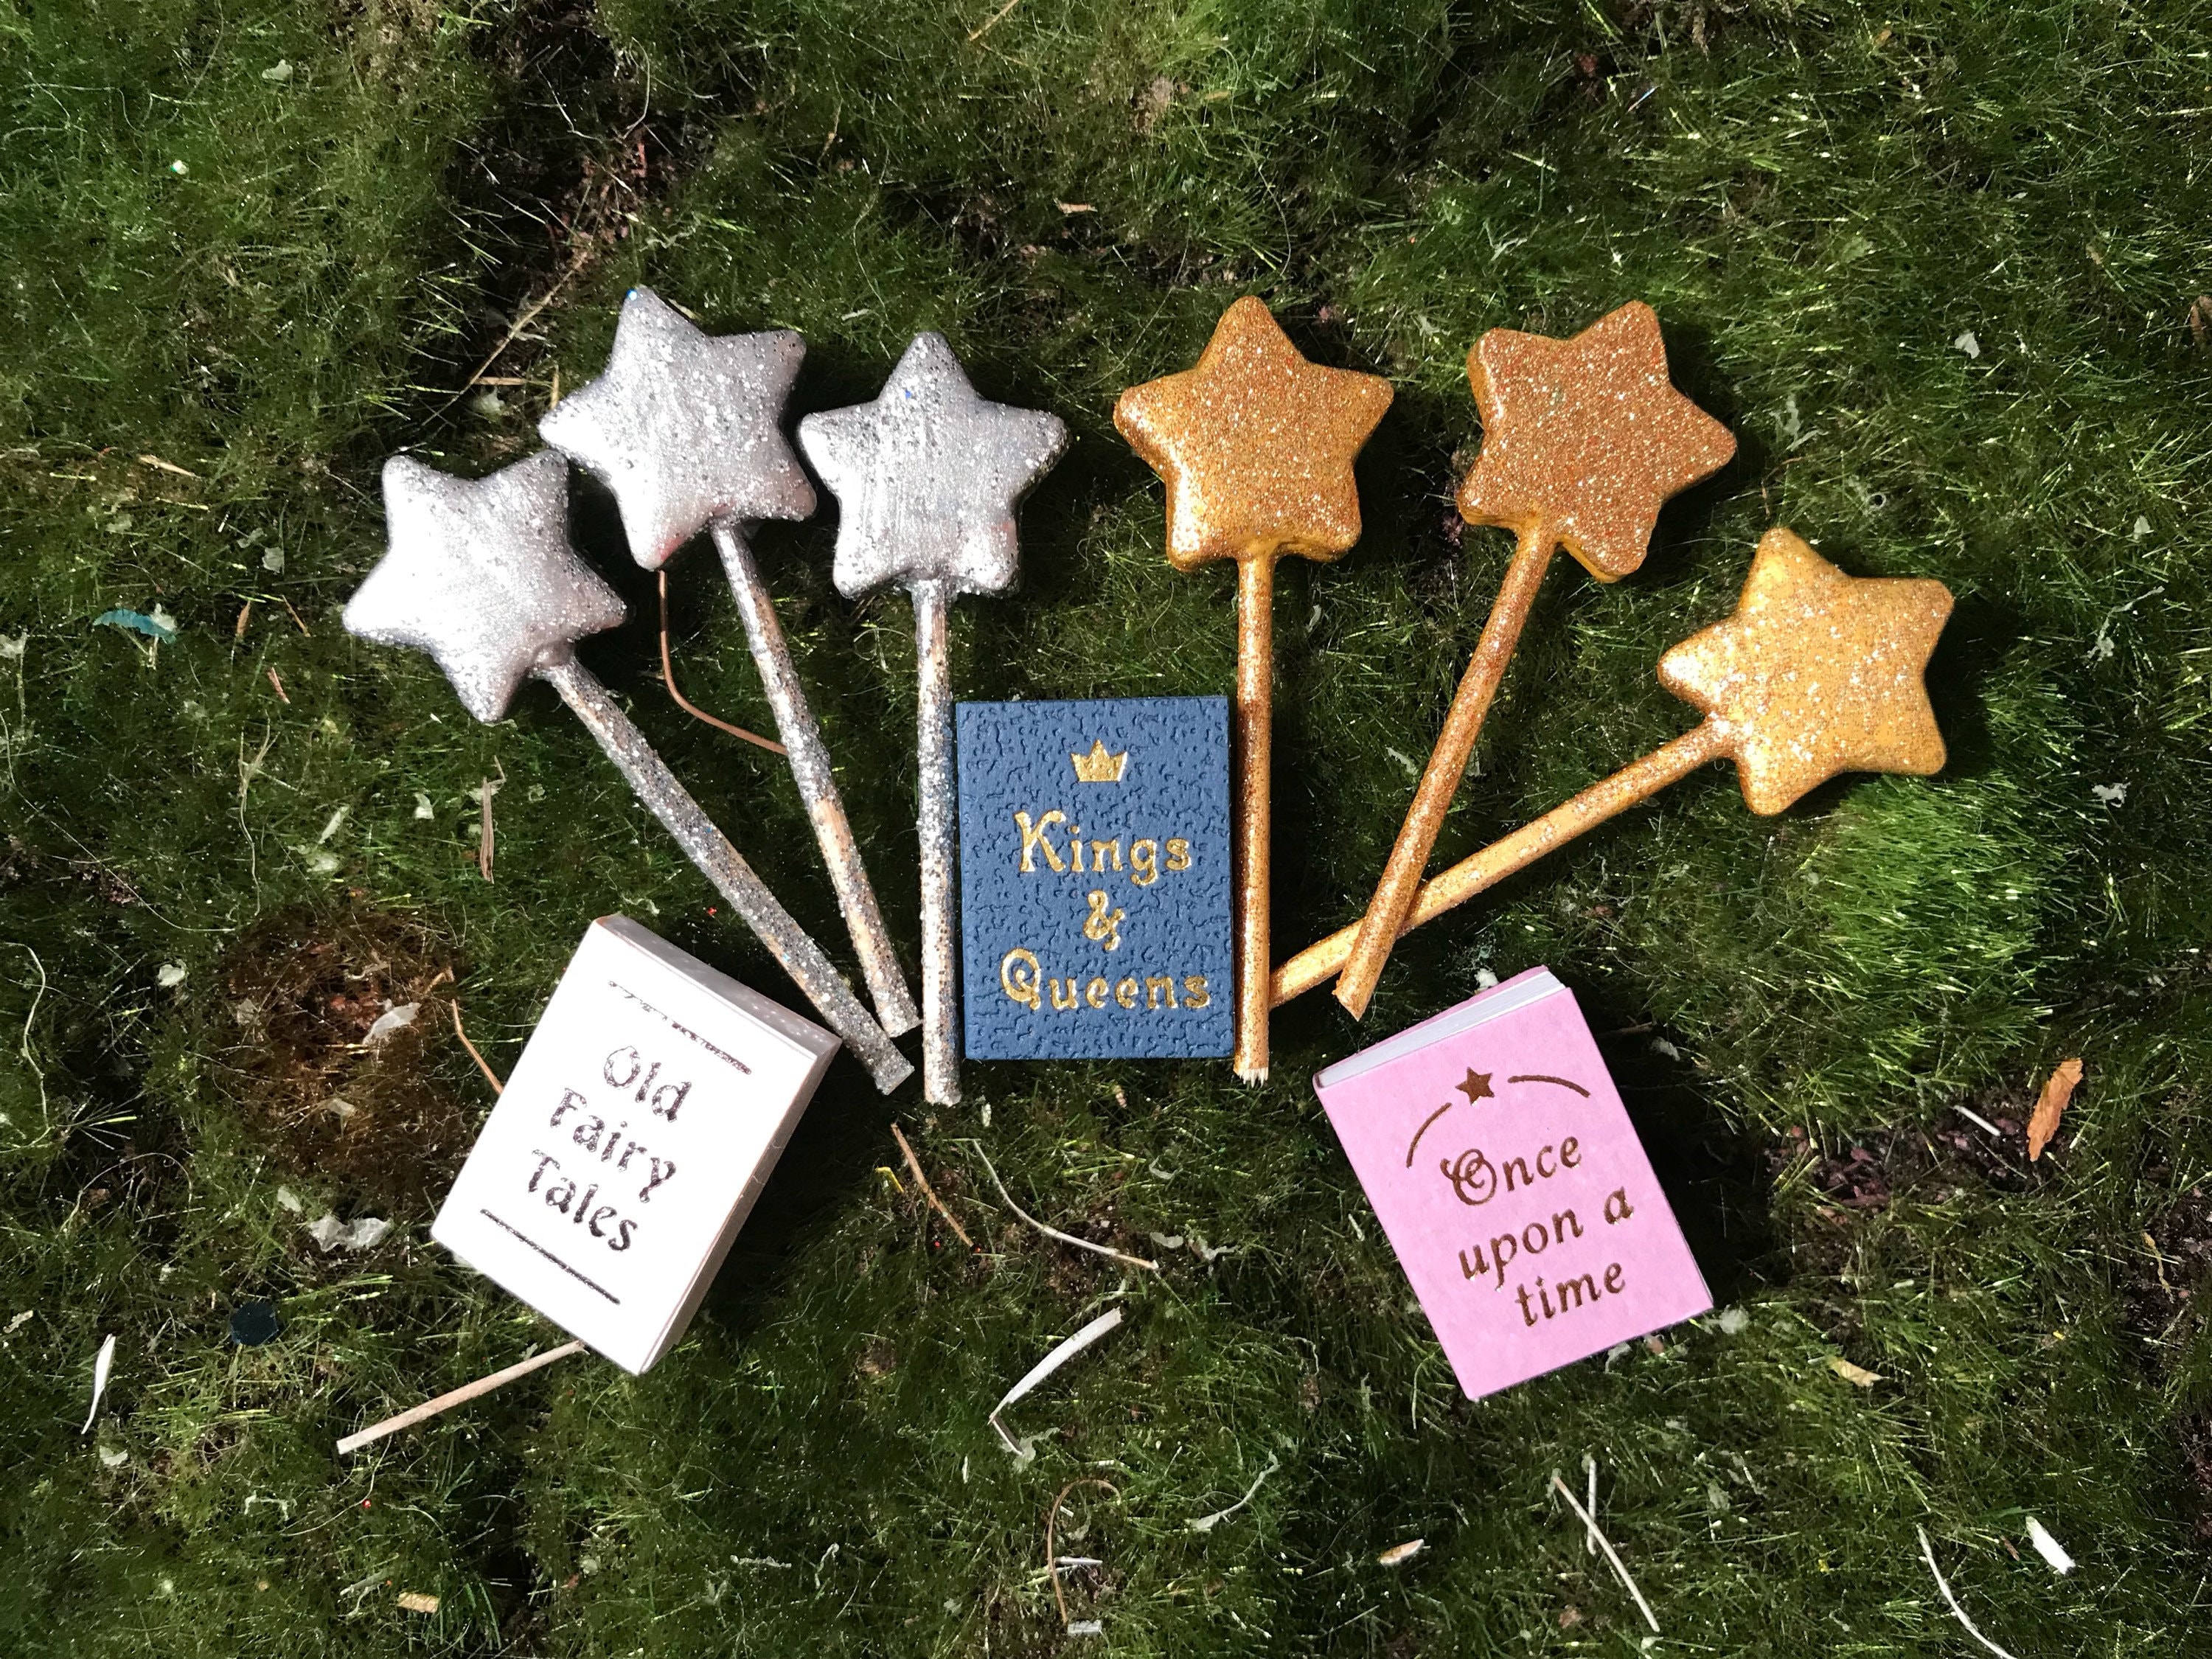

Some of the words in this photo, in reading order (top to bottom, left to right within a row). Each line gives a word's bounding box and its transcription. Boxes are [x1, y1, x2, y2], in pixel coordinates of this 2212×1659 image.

[1014, 810, 1192, 886] Kings
[1082, 889, 1126, 951] &
[1000, 947, 1211, 1011] Queens
[603, 1045, 692, 1123] Old
[549, 1087, 677, 1203] Fairy
[1439, 1135, 1582, 1206] Once
[527, 1148, 639, 1253] Tales
[1457, 1208, 1585, 1292] upon
[1603, 1185, 1635, 1225] a
[1514, 1261, 1626, 1327] time
